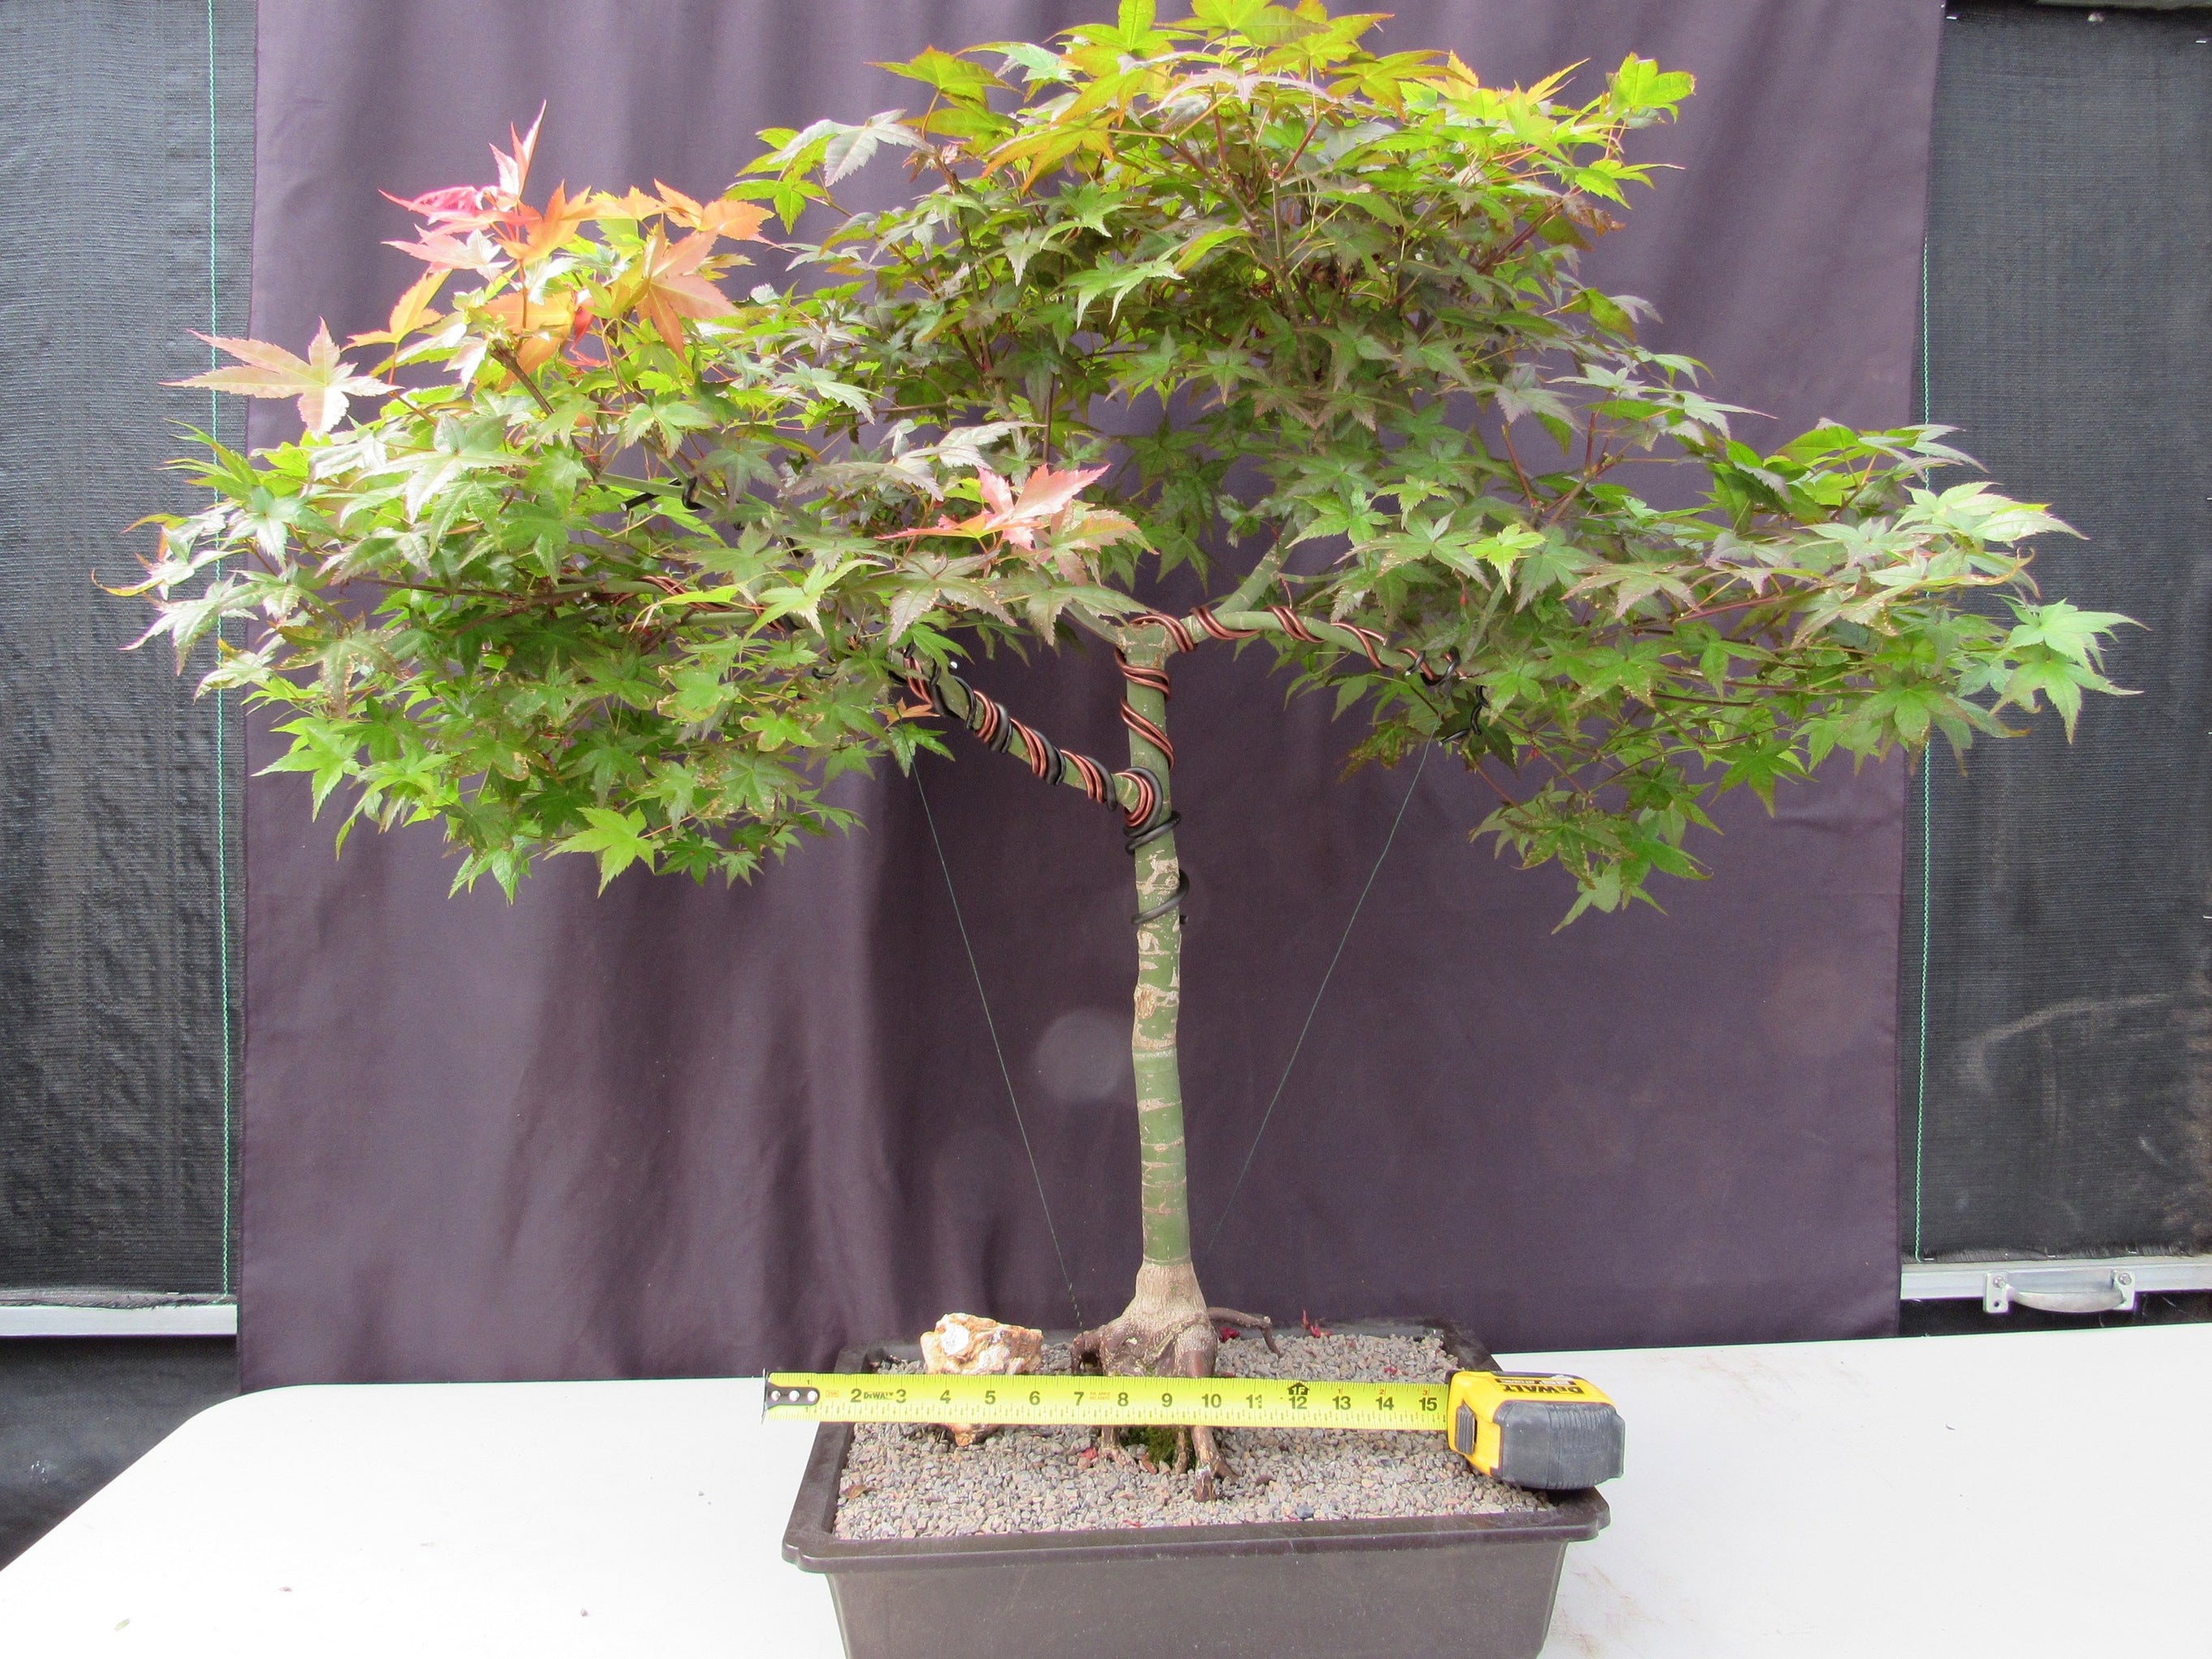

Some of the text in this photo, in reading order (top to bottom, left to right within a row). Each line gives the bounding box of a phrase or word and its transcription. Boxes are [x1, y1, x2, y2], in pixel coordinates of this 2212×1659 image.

[851, 1388, 862, 1403] 2
[896, 1389, 906, 1403] 3
[940, 1390, 951, 1404] 4
[985, 1390, 995, 1404] 5
[1029, 1391, 1041, 1405] 6
[1074, 1392, 1084, 1406] 7
[1118, 1393, 1128, 1407] 8
[1162, 1393, 1172, 1407] 9
[1201, 1394, 1222, 1407] 10
[1245, 1394, 1261, 1409] 11
[1288, 1396, 1307, 1409] 12
[1333, 1396, 1351, 1410] 13
[1375, 1397, 1394, 1411] 14
[1419, 1398, 1437, 1411] 15
